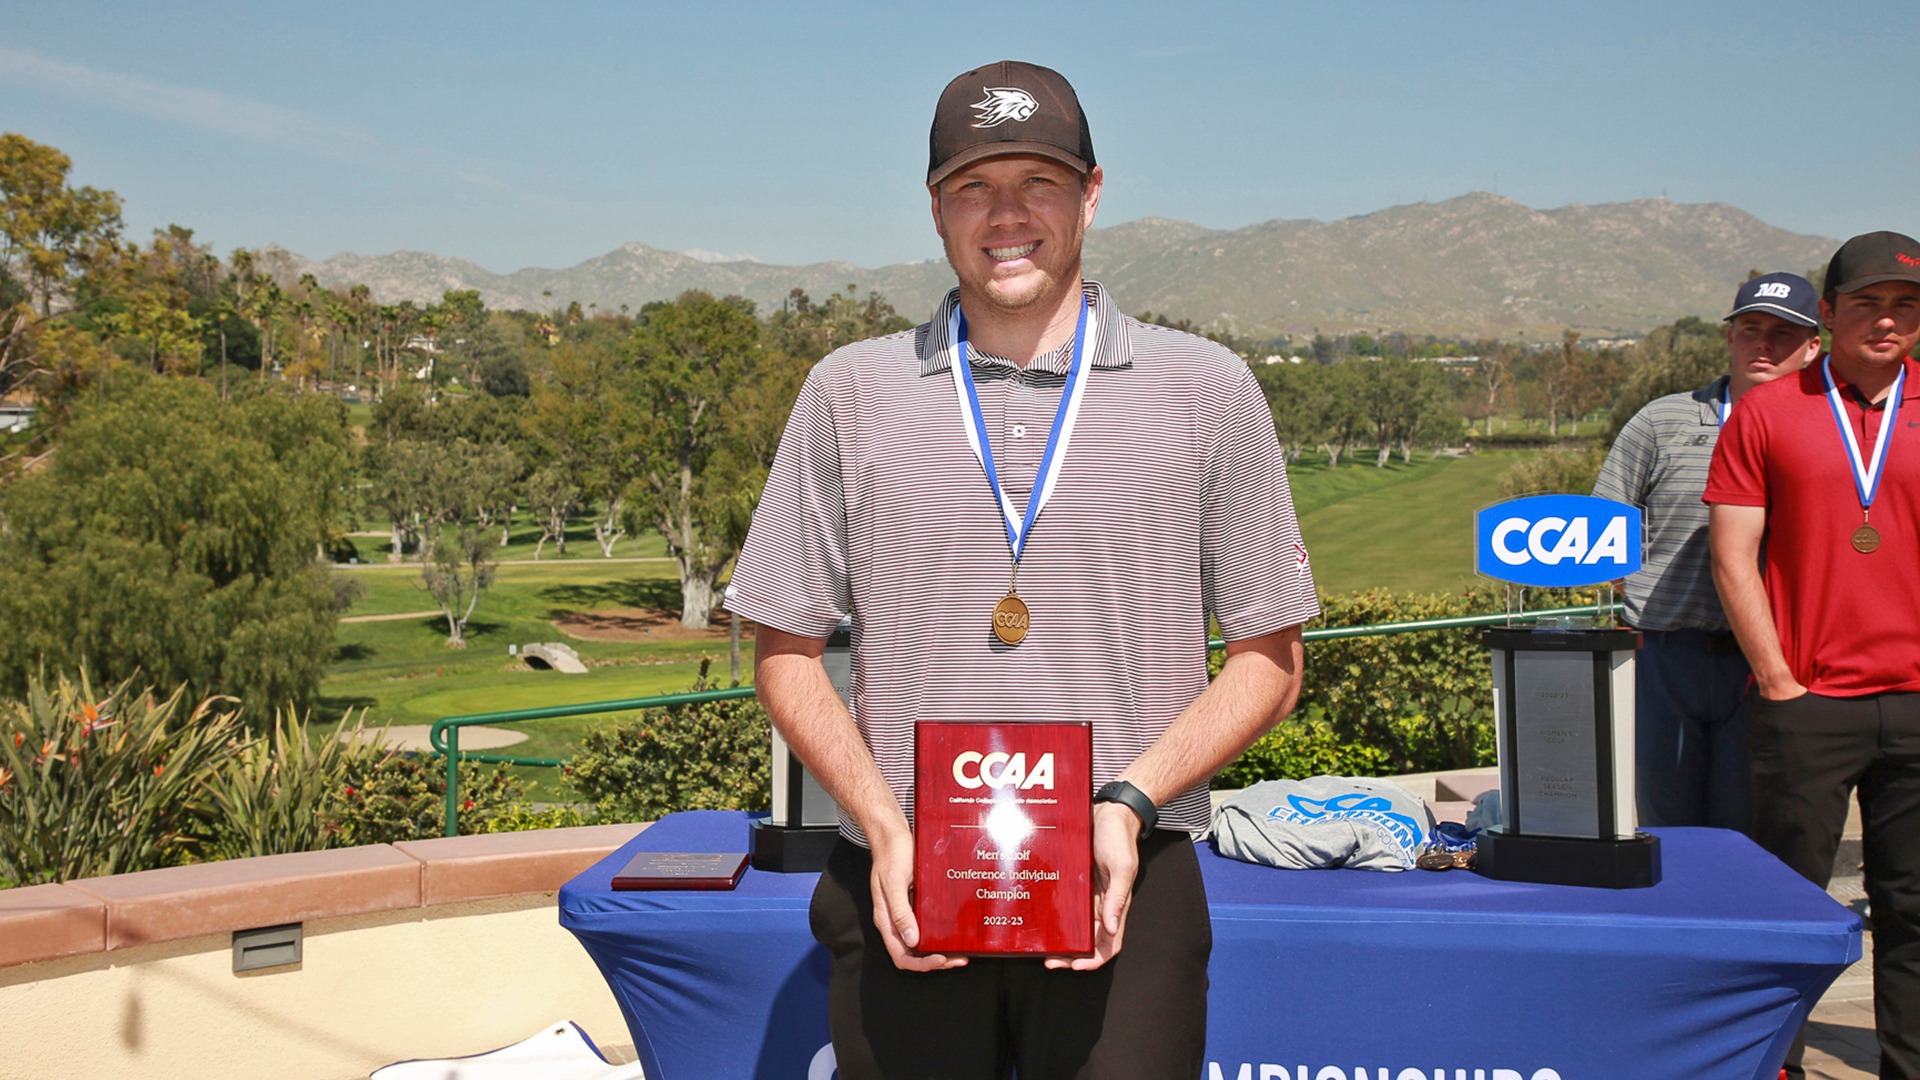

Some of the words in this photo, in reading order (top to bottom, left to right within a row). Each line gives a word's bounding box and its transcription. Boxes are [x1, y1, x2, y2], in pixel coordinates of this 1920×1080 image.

[1754, 282, 1791, 299] MB
[1491, 516, 1627, 565] CCAA
[995, 611, 1028, 629] CCAA
[952, 751, 1054, 790] CCAA
[946, 868, 1006, 880] Conference
[1009, 868, 1060, 881] Individual
[976, 887, 1030, 901] Champion
[983, 916, 1024, 926] 2022-23
